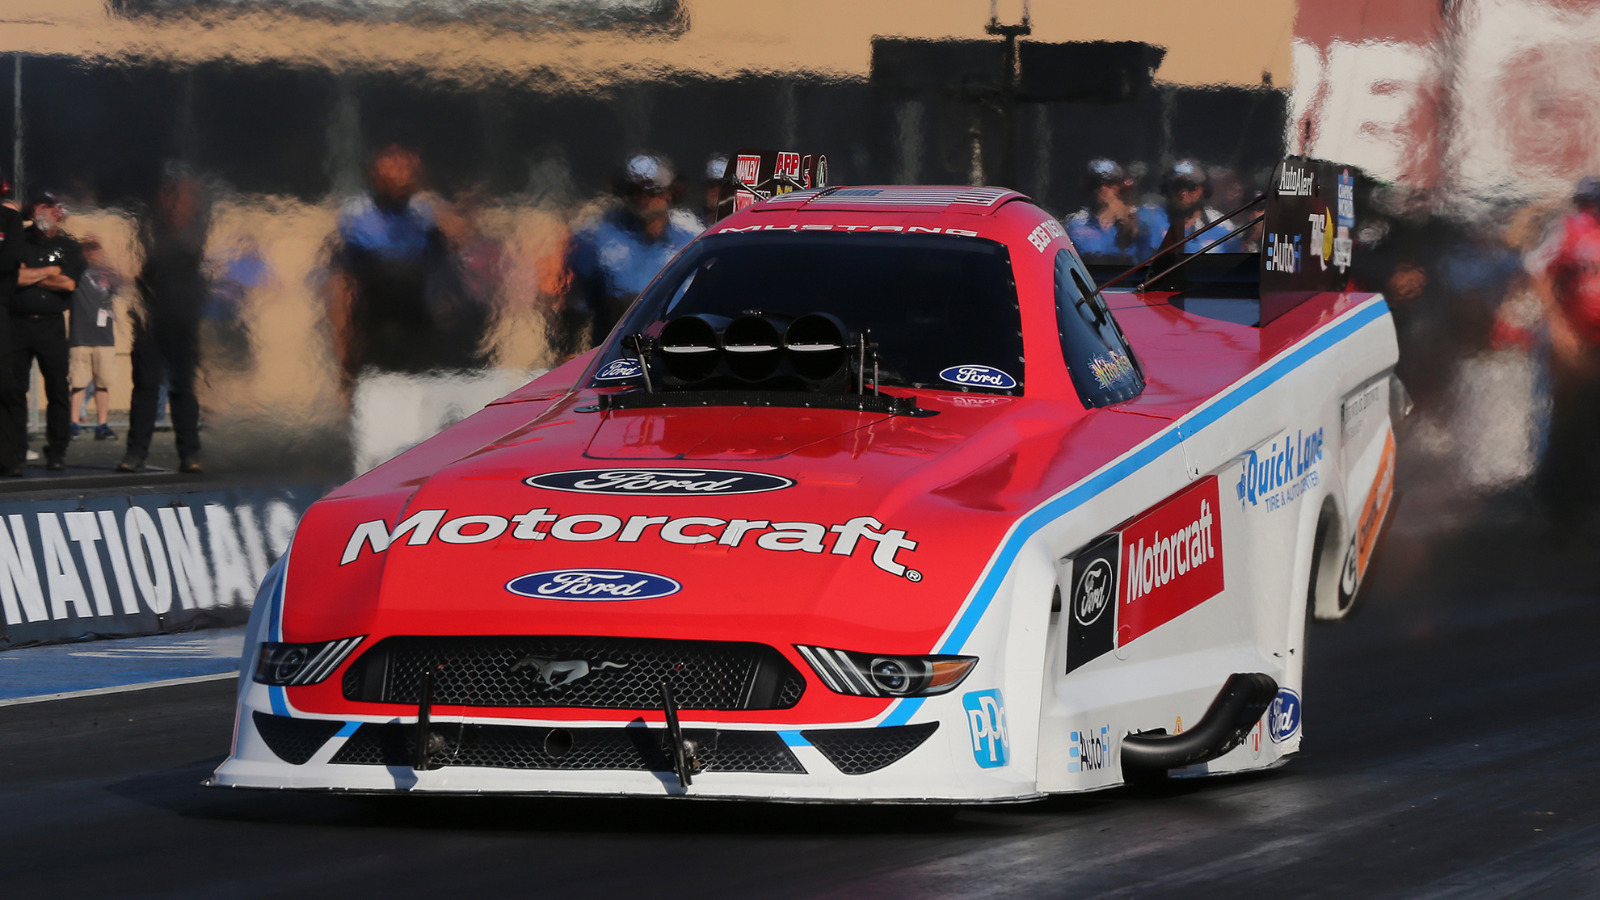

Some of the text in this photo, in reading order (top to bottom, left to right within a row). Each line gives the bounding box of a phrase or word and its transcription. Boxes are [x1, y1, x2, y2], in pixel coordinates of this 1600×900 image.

[775, 153, 800, 175] ARP
[1279, 162, 1315, 196] AutoAlert
[718, 223, 978, 238] MUSTANG
[1027, 225, 1052, 253] BOB
[601, 361, 640, 378] Ford
[956, 367, 1003, 386] Ford
[574, 471, 743, 491] Ford
[1247, 434, 1295, 506] Quick
[1297, 426, 1324, 477] Lane
[340, 508, 917, 580] Motorcraft
[1126, 498, 1215, 605] Motorcraft
[537, 572, 648, 596] Ford
[1081, 567, 1108, 617] Ford
[1272, 697, 1294, 740] Ford
[1080, 723, 1111, 773] AutoFi
